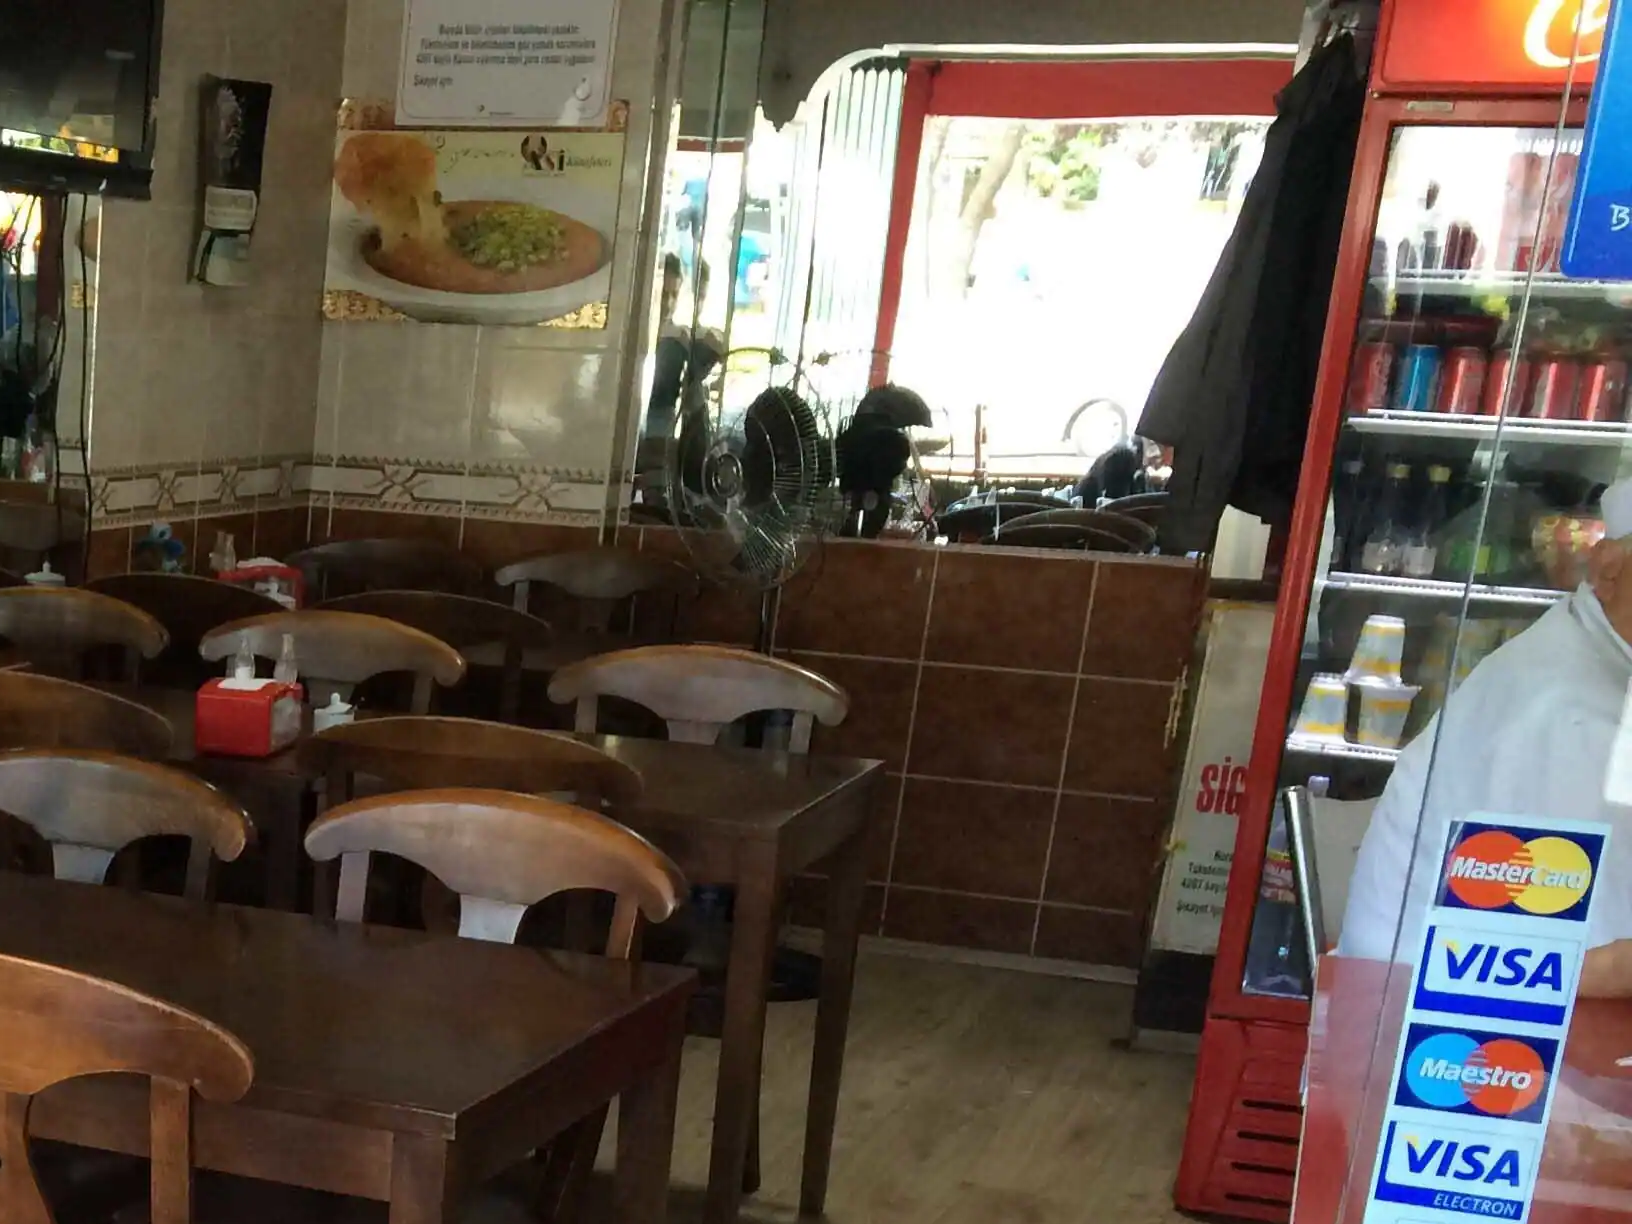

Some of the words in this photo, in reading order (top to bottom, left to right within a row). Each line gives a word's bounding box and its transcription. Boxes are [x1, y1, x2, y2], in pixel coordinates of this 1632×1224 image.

[1450, 856, 1587, 890] MasterCard
[1443, 941, 1562, 992] VISA
[1420, 1057, 1532, 1090] Maestro
[1405, 1136, 1520, 1188] VISA
[1433, 1193, 1517, 1217] ELECTRON
